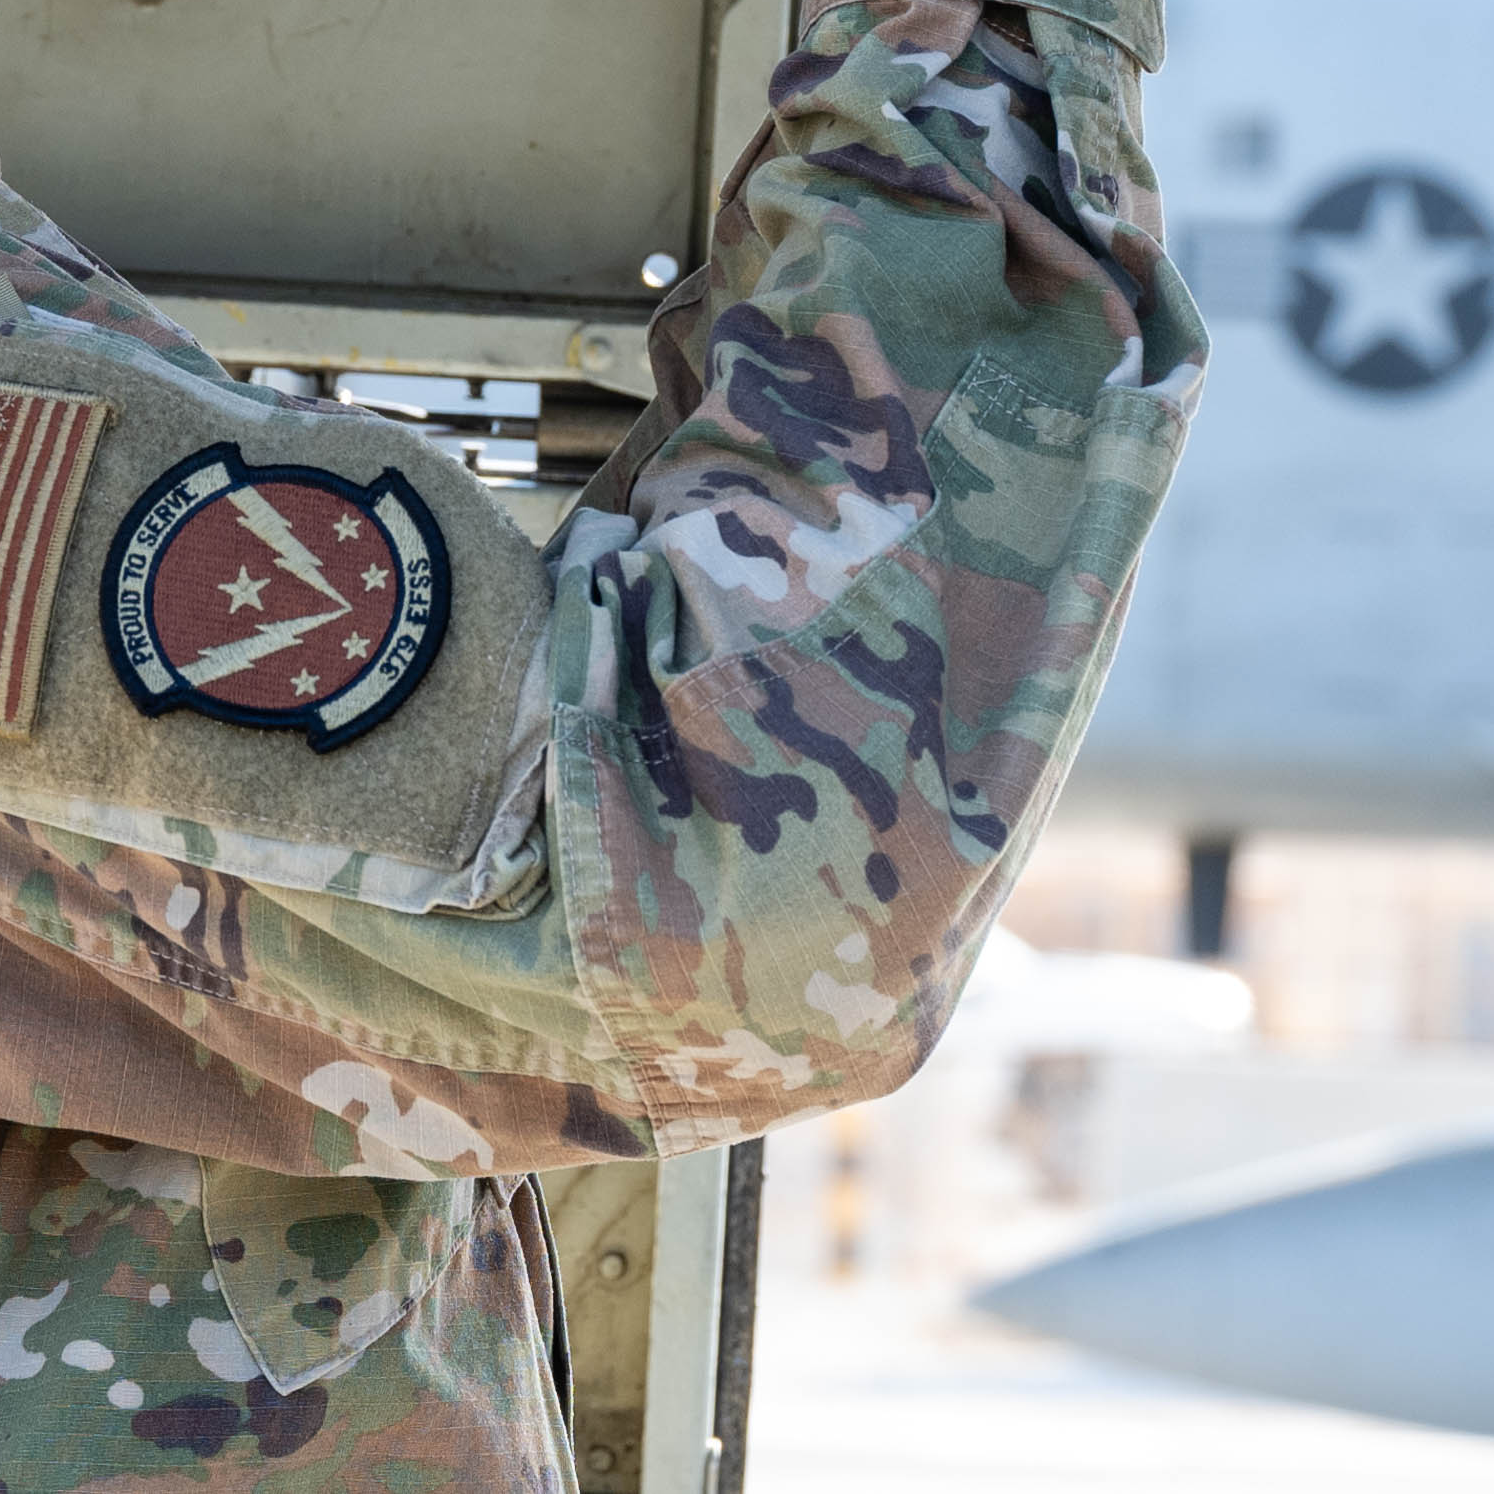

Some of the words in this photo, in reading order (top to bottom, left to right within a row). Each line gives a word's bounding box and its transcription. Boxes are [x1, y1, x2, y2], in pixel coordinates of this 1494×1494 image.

[137, 481, 199, 547] SERVE
[122, 553, 147, 582] TO
[120, 589, 154, 667] PROUD
[379, 634, 418, 681] 379
[406, 557, 430, 626] EFSS
